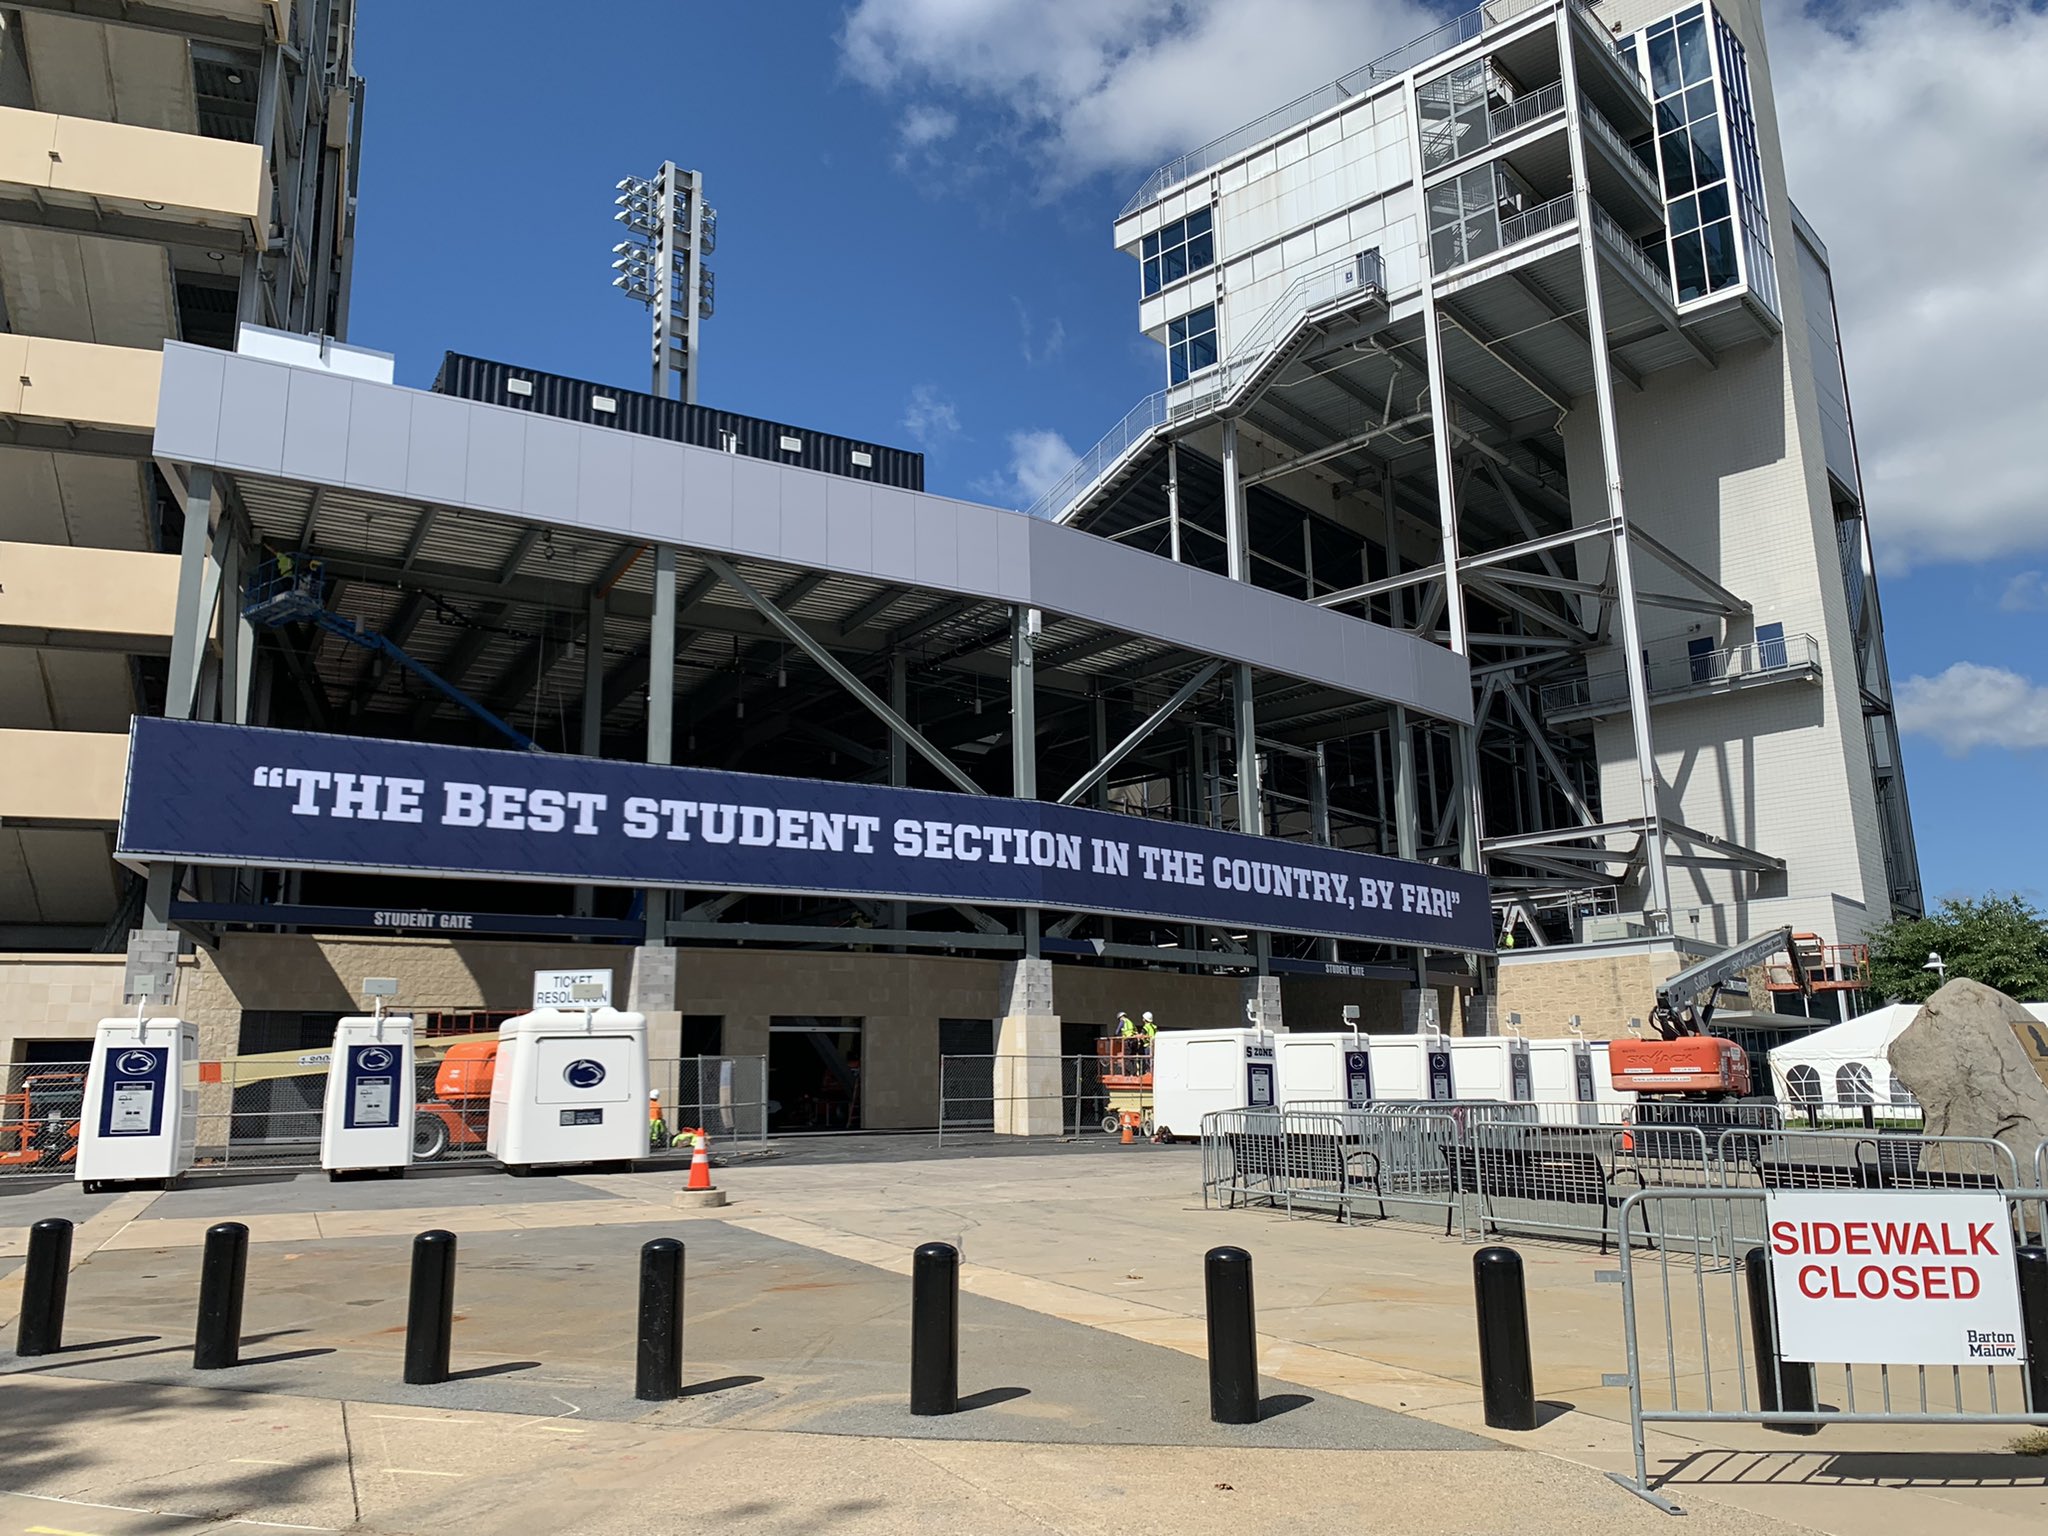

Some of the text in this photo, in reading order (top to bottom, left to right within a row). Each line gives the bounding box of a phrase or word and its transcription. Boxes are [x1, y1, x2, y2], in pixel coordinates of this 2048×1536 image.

[441, 781, 608, 835] BEST
[622, 796, 880, 854] STUDENT
[893, 818, 1082, 871] SECTION
[1091, 838, 1130, 877] IN
[1138, 845, 1205, 886] THE
[1212, 856, 1355, 910] COUNTRY,
[1359, 877, 1395, 910] BY
[373, 911, 473, 929] STUDENT GATE
[1325, 963, 1365, 977] STUDENT GATE
[1246, 1046, 1273, 1058] S ZONE
[1771, 1220, 1999, 1256] SIDEWALK
[1798, 1264, 1981, 1300] CLOSED
[1967, 1330, 2015, 1343] Barton
[1969, 1344, 2016, 1357] Malow
